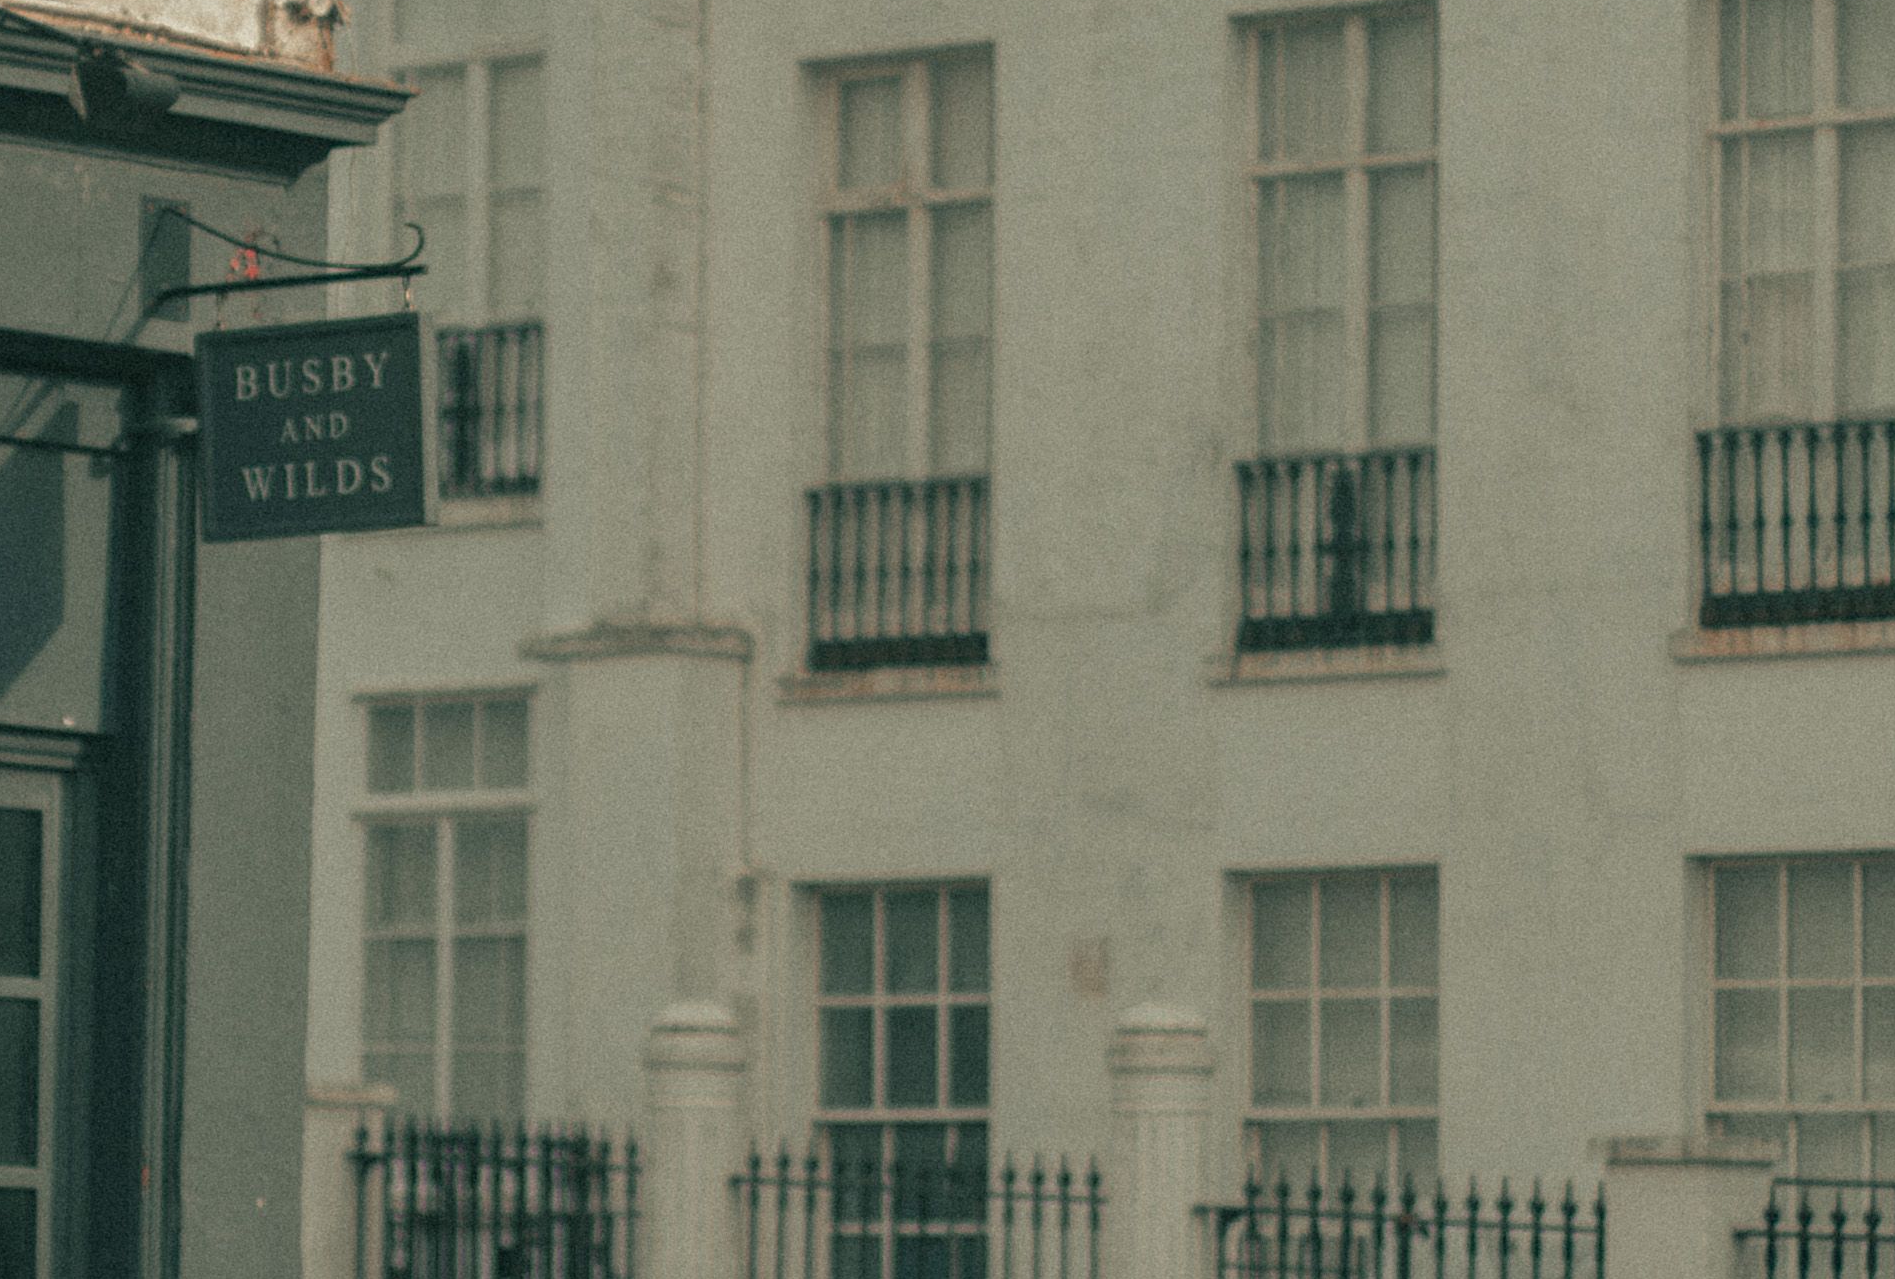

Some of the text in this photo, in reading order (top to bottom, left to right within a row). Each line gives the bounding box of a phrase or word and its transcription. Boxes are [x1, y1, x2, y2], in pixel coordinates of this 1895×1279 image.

[235, 351, 389, 401] BUSBY
[280, 412, 348, 443] AND
[241, 455, 392, 503] WILDS
